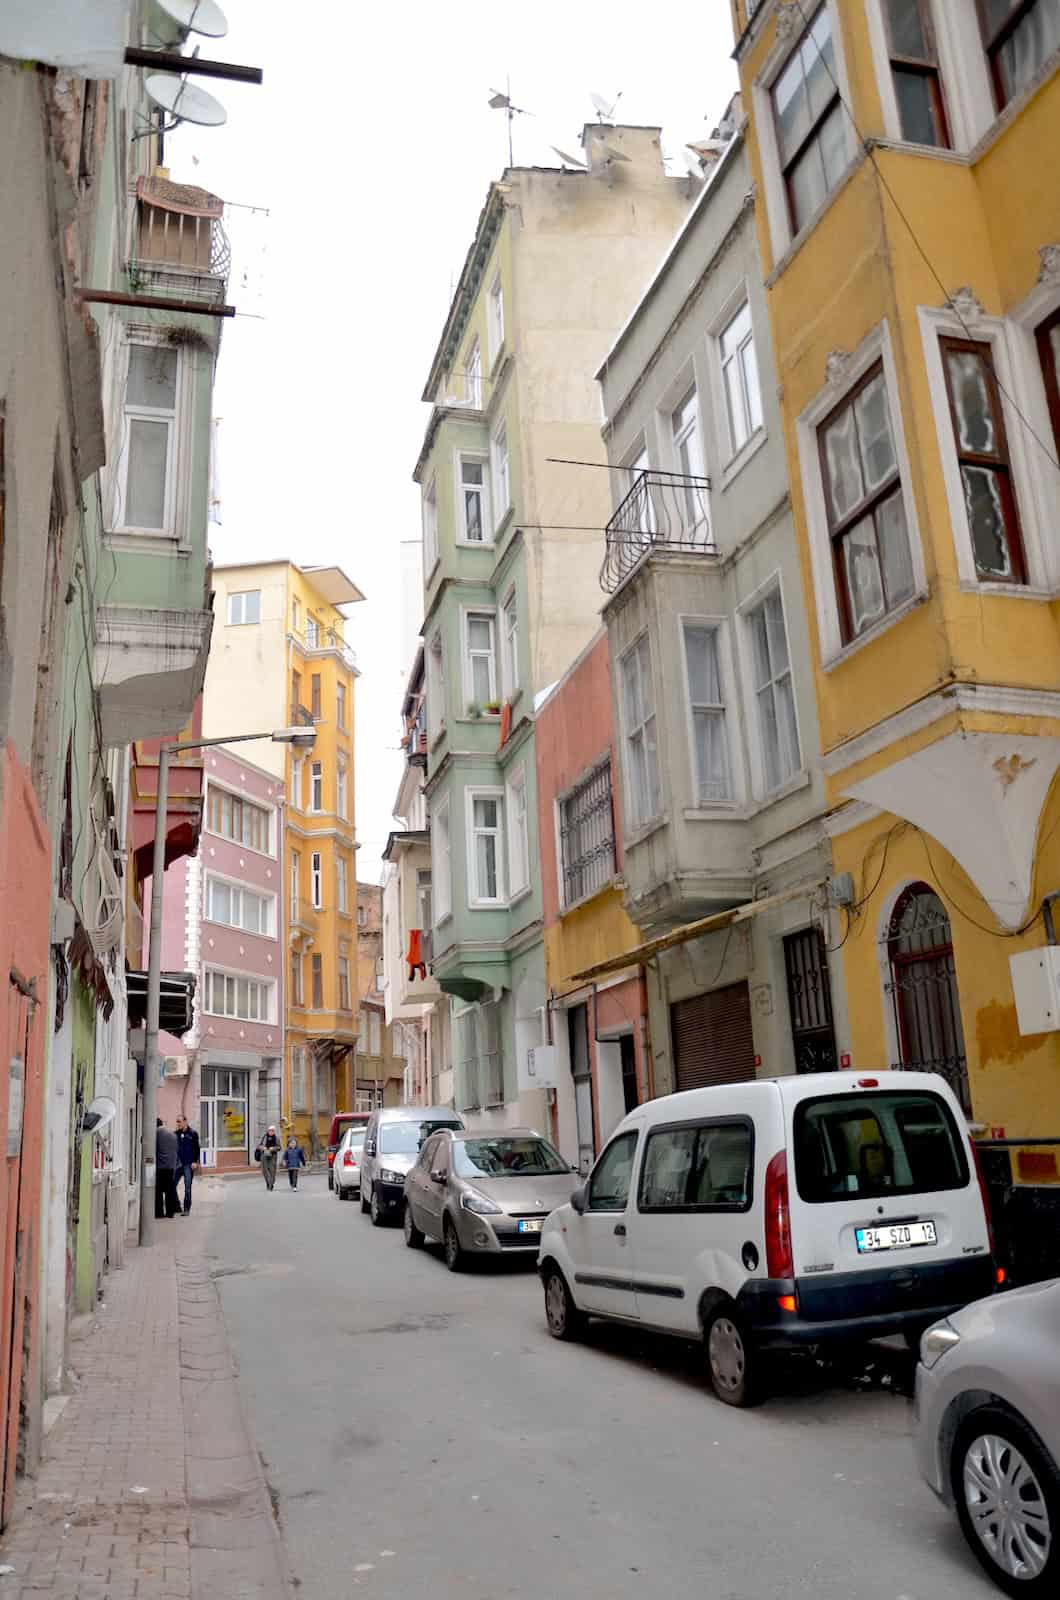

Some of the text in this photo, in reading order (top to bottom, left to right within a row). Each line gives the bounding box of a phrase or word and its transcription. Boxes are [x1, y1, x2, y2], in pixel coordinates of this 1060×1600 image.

[866, 1224, 934, 1247] 34 SZD 12
